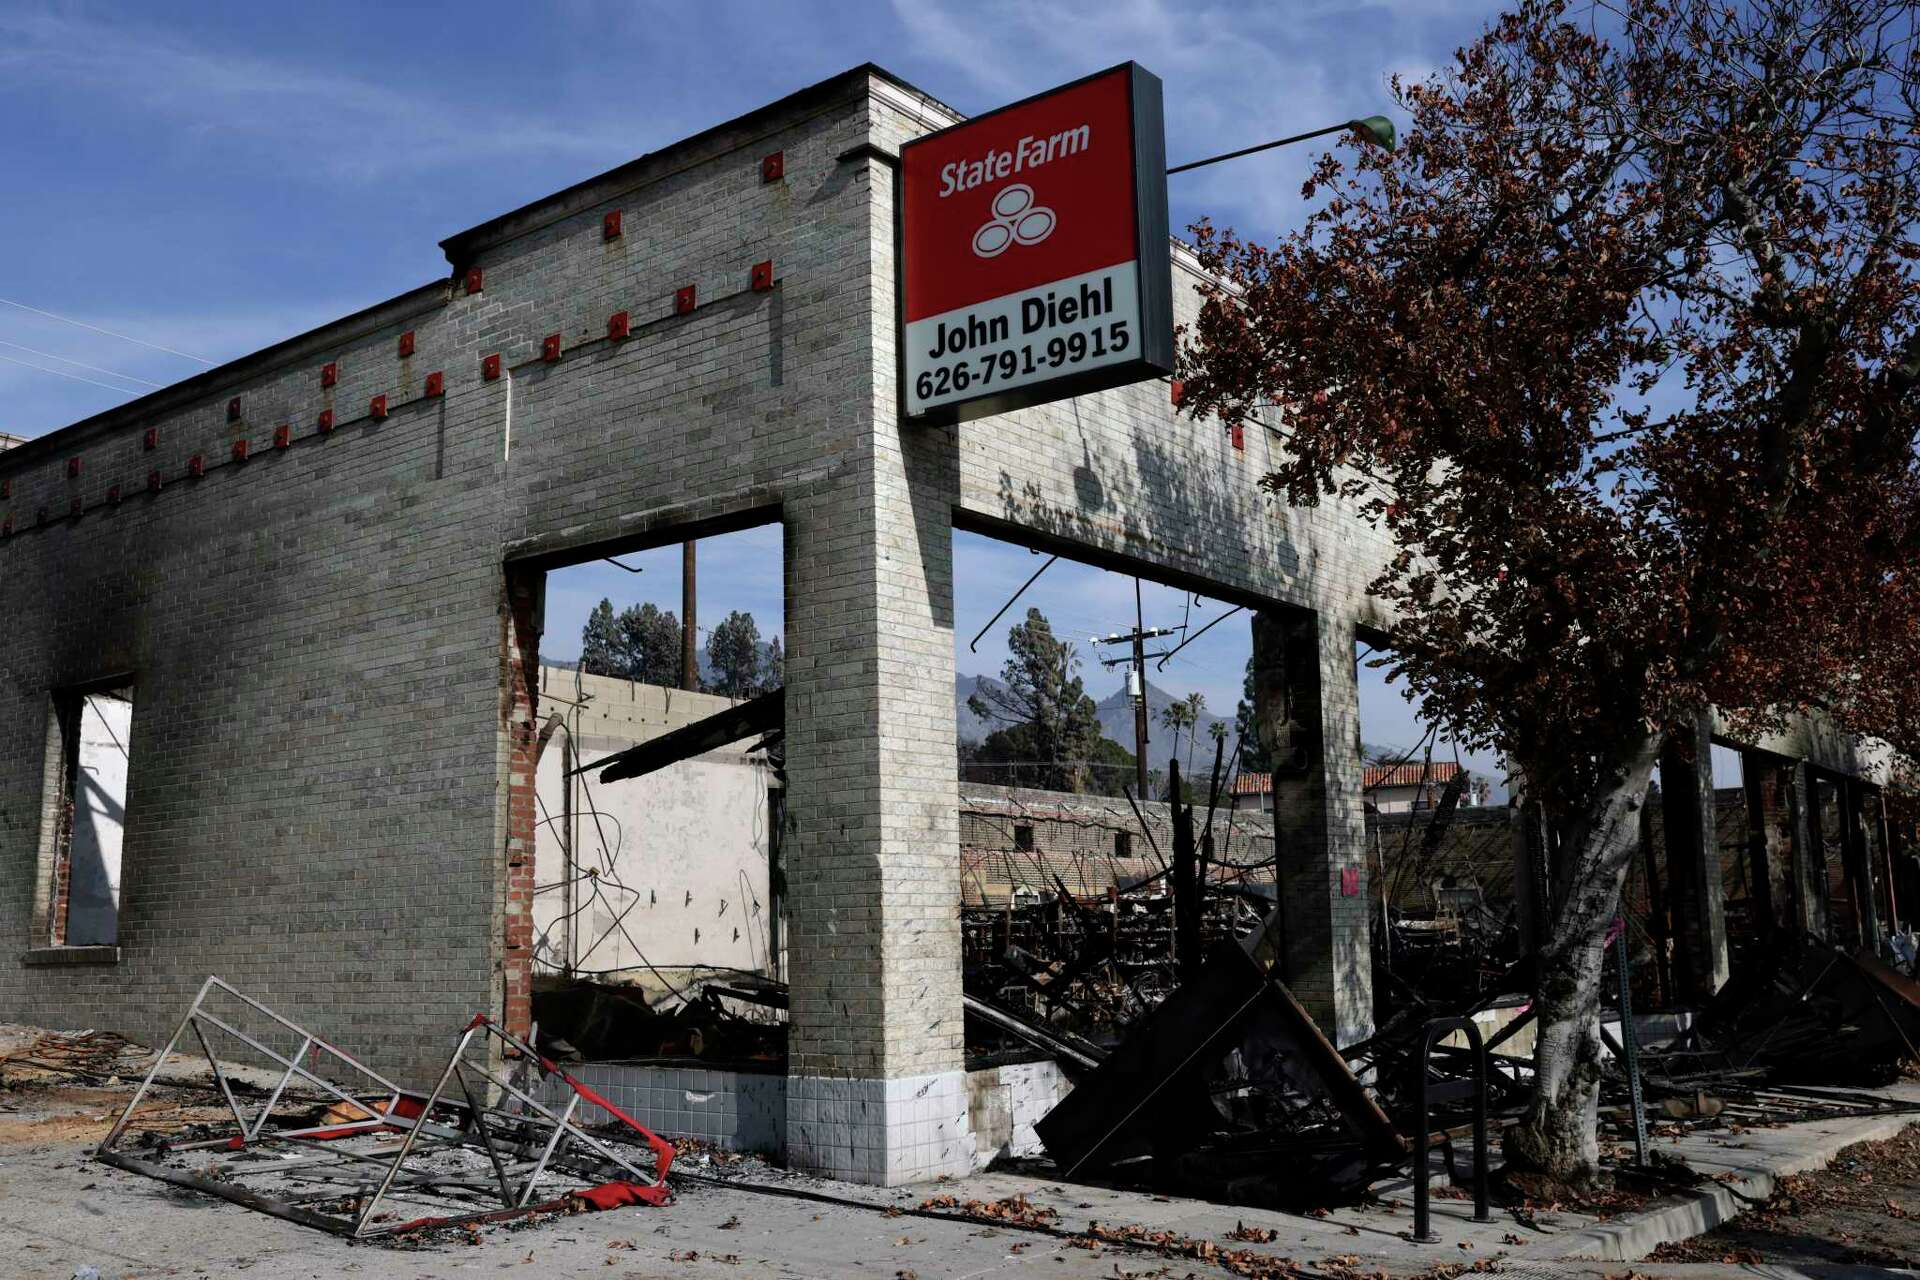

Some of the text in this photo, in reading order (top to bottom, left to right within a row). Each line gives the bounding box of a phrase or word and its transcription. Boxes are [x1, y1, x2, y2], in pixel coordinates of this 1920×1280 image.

[929, 277, 1113, 359] John Diehl
[917, 321, 1130, 400] 626-791-9915
